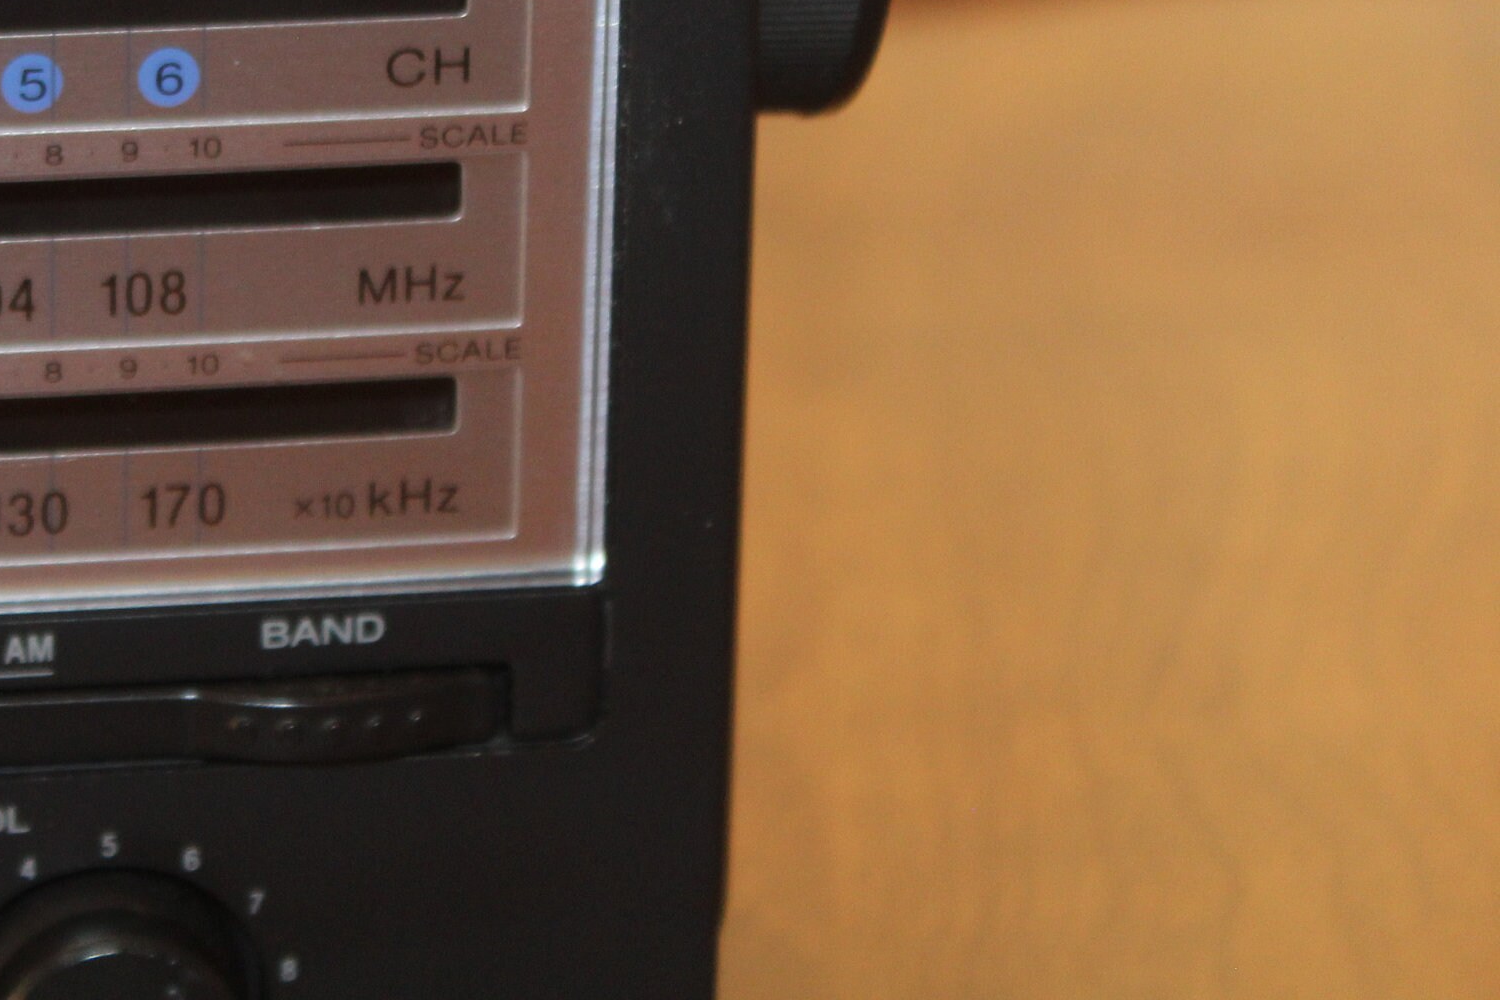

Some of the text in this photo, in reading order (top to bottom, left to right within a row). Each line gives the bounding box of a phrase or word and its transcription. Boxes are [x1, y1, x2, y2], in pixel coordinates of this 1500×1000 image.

[19, 67, 47, 102] 5
[155, 62, 184, 96] 6
[386, 47, 471, 88] CH
[45, 144, 64, 166] 8
[121, 141, 139, 163] 9
[190, 137, 222, 159] 10
[419, 124, 528, 150] SCALE
[102, 270, 186, 317] 108
[357, 265, 466, 306] MHz
[414, 338, 523, 364] SCALE
[44, 362, 63, 383] 8
[120, 358, 138, 380] 9
[189, 355, 220, 376] 10
[141, 482, 226, 528] 170
[368, 476, 460, 517] kHz
[260, 612, 387, 650] BAND
[3, 634, 55, 665] AM
[101, 831, 119, 858] 5
[182, 845, 200, 872] 6
[19, 856, 37, 880] 4
[249, 888, 266, 916] 7
[280, 955, 298, 982] 8
